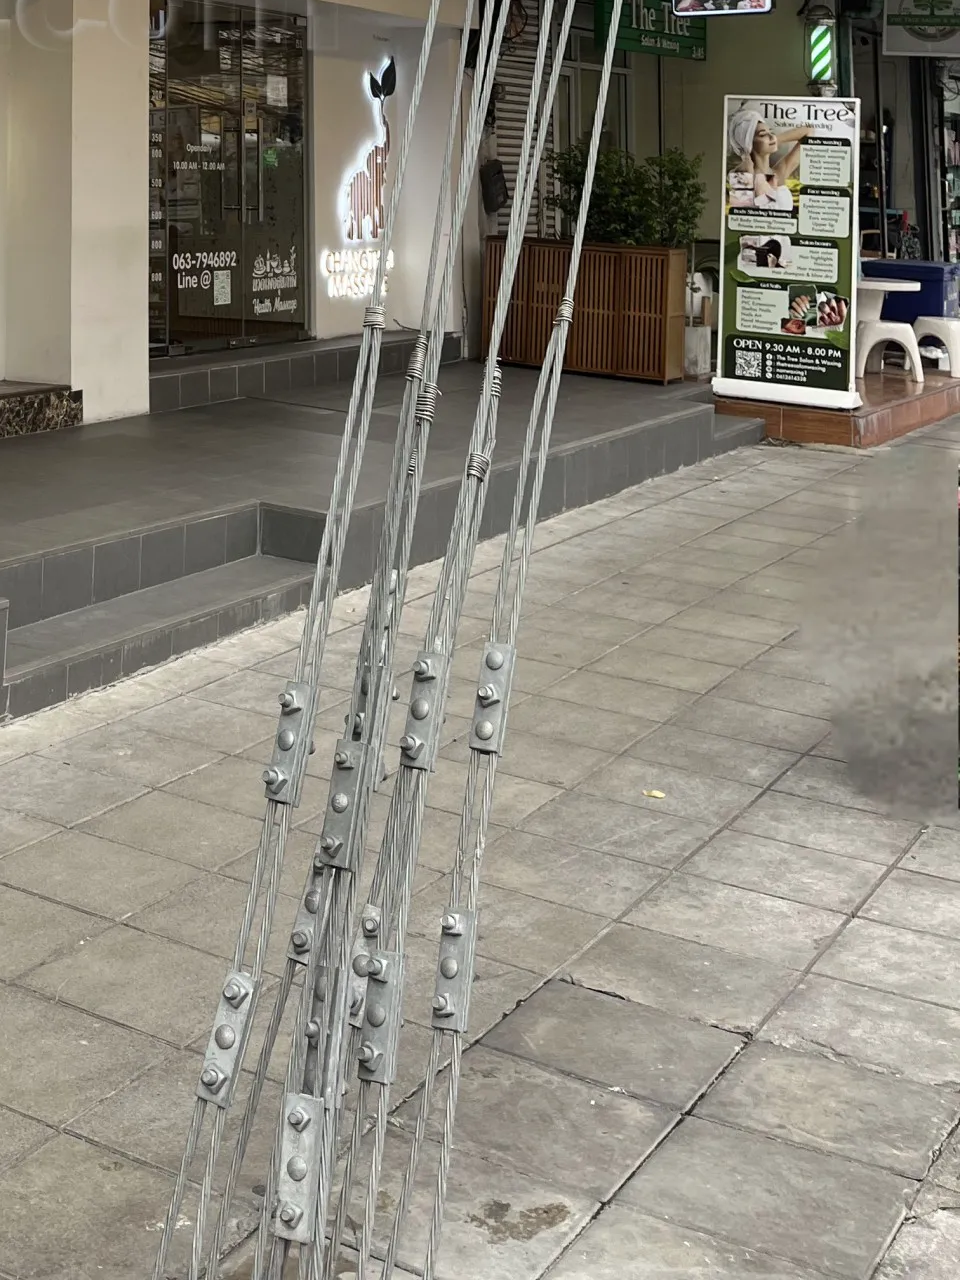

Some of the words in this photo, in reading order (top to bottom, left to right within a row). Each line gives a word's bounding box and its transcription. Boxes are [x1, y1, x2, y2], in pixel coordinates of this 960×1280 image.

[661, 1, 691, 36] Tree
[760, 102, 797, 120] The
[802, 104, 849, 122] Tree
[173, 251, 237, 270] 063-7946892
[323, 249, 395, 274] CHANGTI
[178, 273, 198, 289] Line
[200, 270, 211, 289] @
[328, 272, 390, 297] MASSAE
[252, 298, 272, 315] Health
[273, 297, 297, 313] Massage
[733, 338, 762, 350] OPEN
[765, 343, 784, 352] 9.30
[785, 345, 801, 354] AM
[807, 347, 826, 356] 8.00
[828, 349, 841, 358] PM
